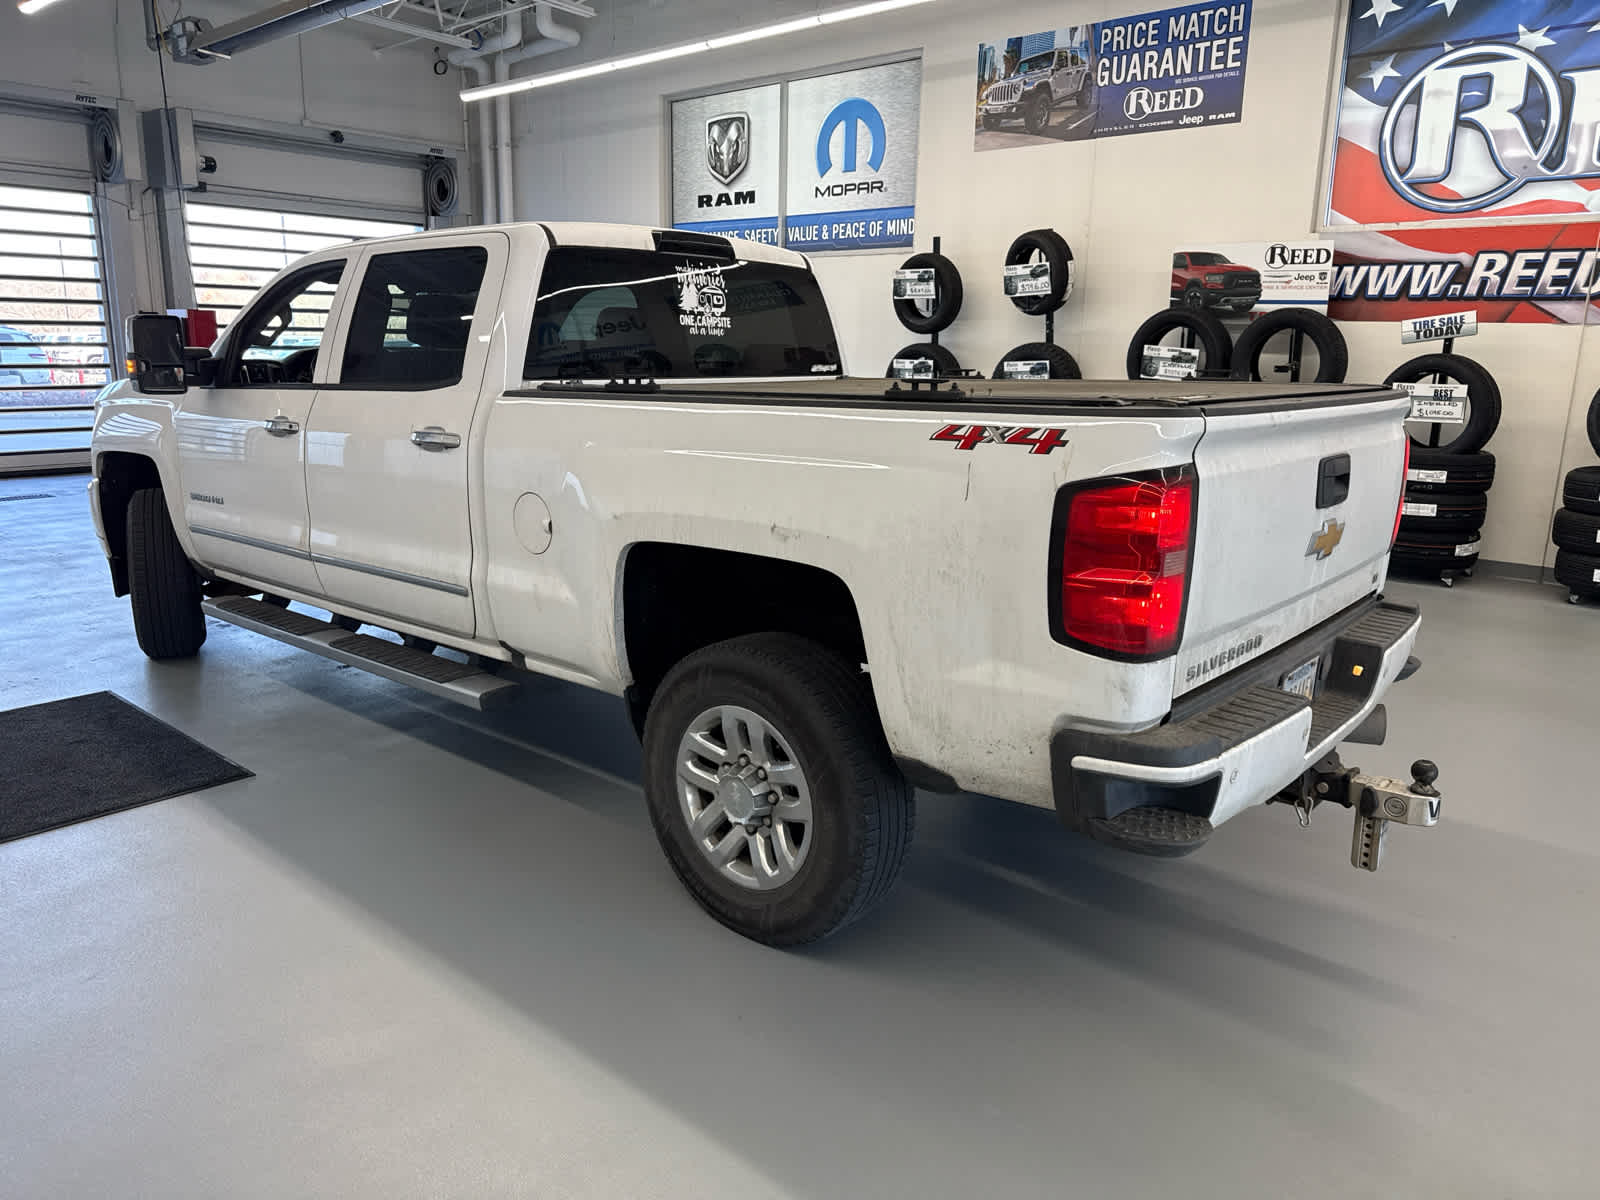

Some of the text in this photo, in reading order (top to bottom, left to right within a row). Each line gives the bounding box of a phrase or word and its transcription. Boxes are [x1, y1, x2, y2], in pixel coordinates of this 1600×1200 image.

[1100, 3, 1246, 54] PRICE MATCH
[1096, 36, 1244, 87] GUARANTEE
[1124, 87, 1204, 120] REED
[1179, 115, 1204, 125] Jeep
[1209, 112, 1236, 120] RAM
[815, 180, 885, 198] MOPAR
[697, 190, 756, 208] RAM
[744, 228, 779, 244] SAFETY
[788, 225, 819, 242] VALUE
[822, 224, 830, 241] &
[832, 222, 866, 239] PEACE
[869, 220, 883, 236] OF
[887, 218, 915, 235] MIND
[1265, 244, 1332, 269] REED
[1294, 272, 1316, 282] Jeep
[680, 314, 731, 329] ONE CAMPSITE
[1412, 314, 1465, 330] TIRE SALE
[1414, 324, 1464, 339] TODAY
[1434, 388, 1454, 398] BEST
[1185, 633, 1264, 682] SILVERADO
